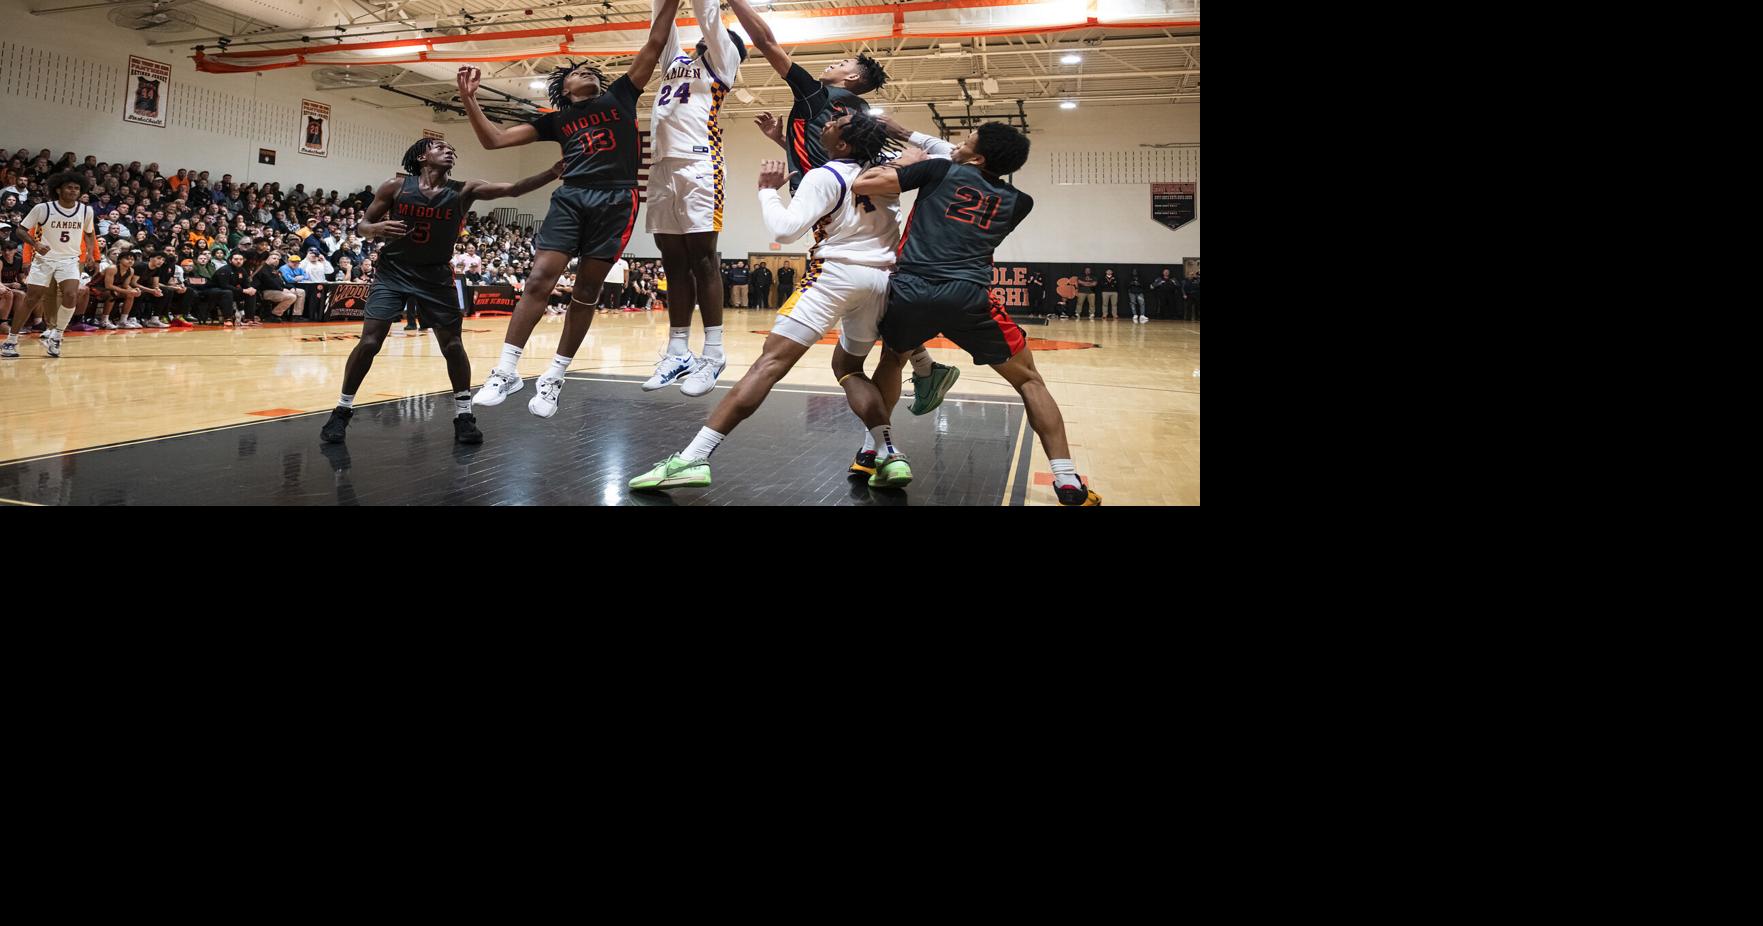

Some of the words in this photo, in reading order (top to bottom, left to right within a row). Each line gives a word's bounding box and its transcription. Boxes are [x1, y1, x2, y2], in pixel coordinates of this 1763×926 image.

[663, 67, 702, 81] AMDEN
[658, 82, 691, 106] 24
[561, 108, 621, 137] MIDDLE
[578, 127, 617, 154] 13
[399, 202, 453, 220] MIDDLE
[945, 185, 1002, 231] 21
[50, 220, 82, 230] CAMDEN
[59, 230, 70, 243] 5
[991, 267, 1027, 286] DLE
[330, 284, 370, 306] MIDDL
[992, 287, 1030, 306] SHI
